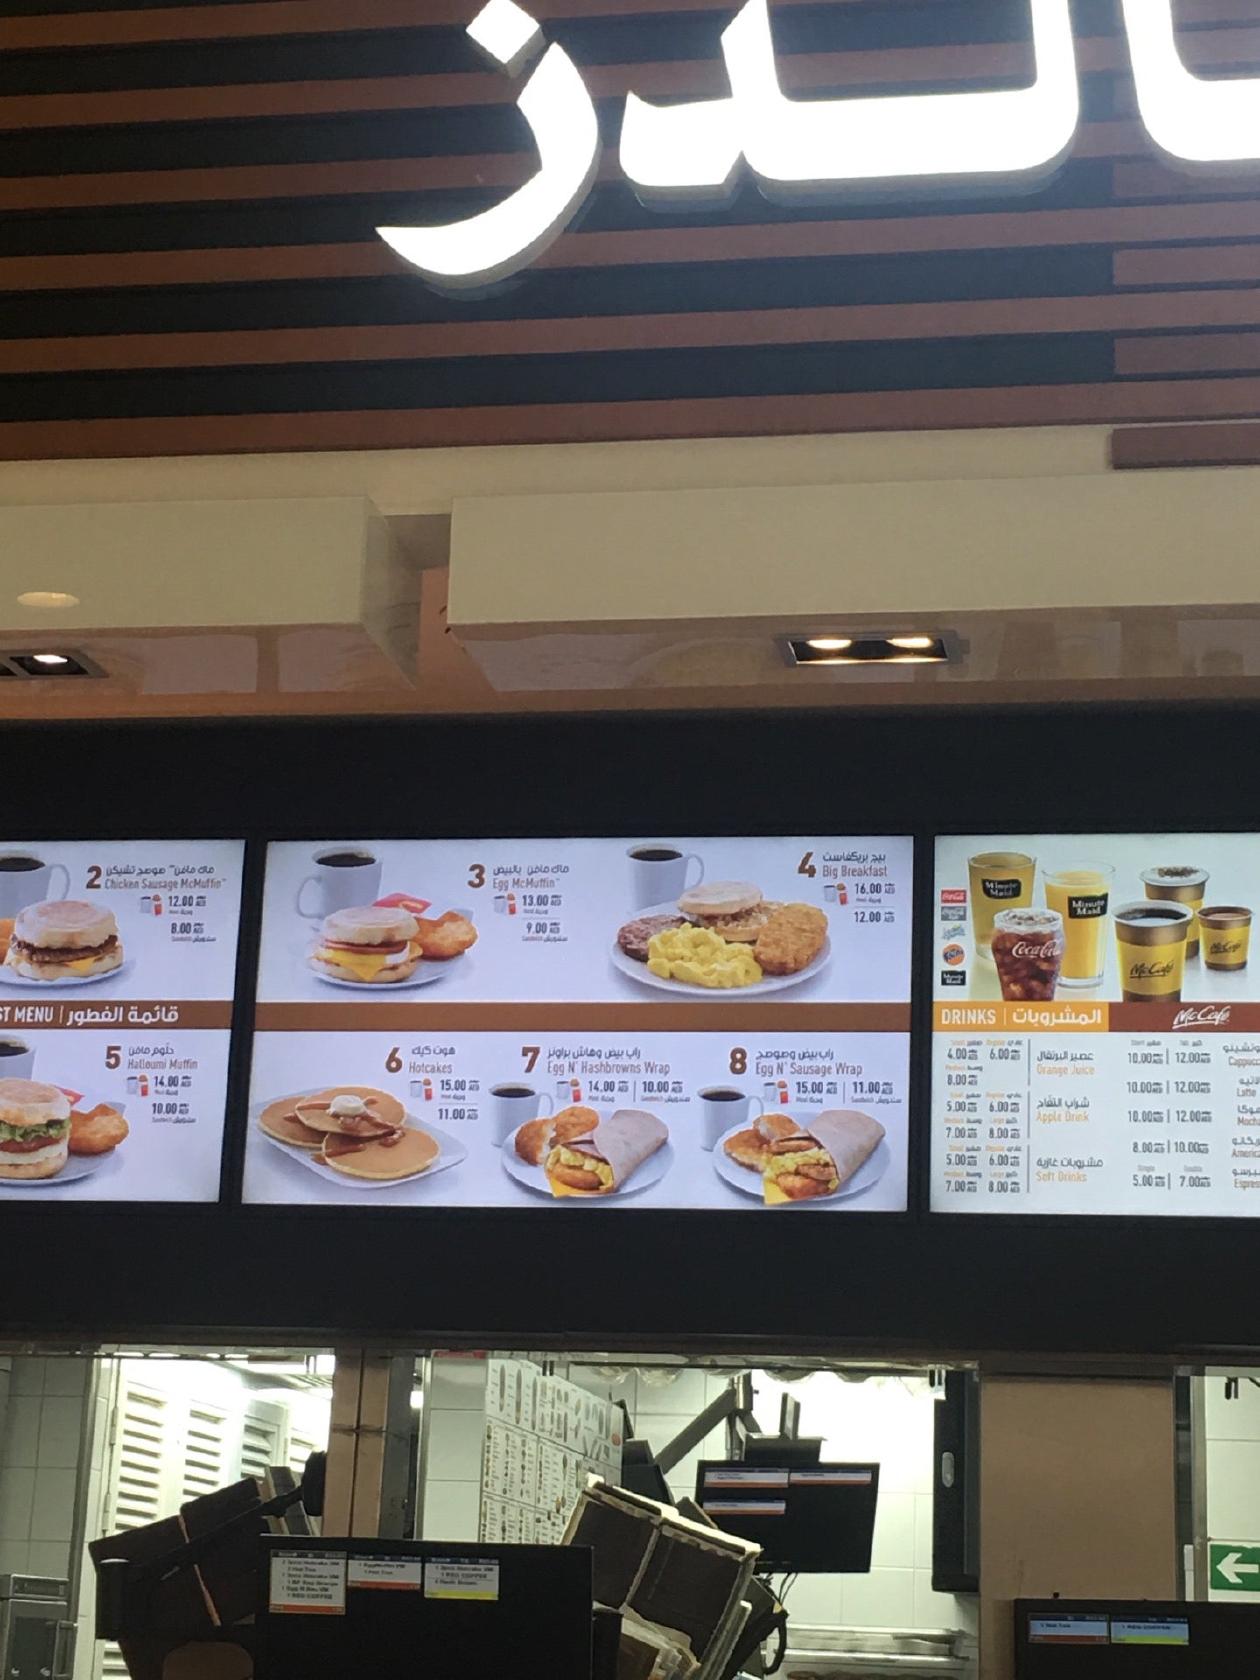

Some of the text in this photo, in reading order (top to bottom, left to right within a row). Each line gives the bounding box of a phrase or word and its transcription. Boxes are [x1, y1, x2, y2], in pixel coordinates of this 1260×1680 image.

[797, 852, 816, 878] 4
[86, 866, 102, 889] 2
[467, 864, 485, 888] 3
[822, 865, 887, 879] Big Breakfast
[105, 878, 139, 889] Chicken
[142, 878, 178, 891] Sausage
[493, 878, 509, 891] Egg
[855, 883, 881, 894] 16.00
[168, 896, 194, 907] 12.00
[522, 895, 548, 906] 13.00
[854, 911, 881, 923] 12.00
[171, 923, 191, 934] 8.00
[527, 922, 547, 934] 9.00
[14, 1006, 54, 1023] MENU
[67, 1005, 178, 1026] قائمة الفطور
[941, 1009, 996, 1024] DRINKS
[1012, 1005, 1101, 1026] المشروبات
[105, 1046, 121, 1069] 5
[947, 1048, 966, 1059] 4.00
[990, 1048, 1009, 1060] 6.00
[1128, 1053, 1152, 1064] 10.00
[1175, 1052, 1200, 1063] 12.00
[128, 1059, 198, 1069] Halloumi Muffin
[385, 1047, 403, 1073] 6
[522, 1047, 541, 1073] 7
[729, 1047, 747, 1075] 8
[409, 1062, 452, 1074] Hotcakes
[548, 1062, 564, 1076] Egg
[582, 1061, 641, 1073] Hashbrowns
[644, 1061, 670, 1076] Wrap
[756, 1063, 773, 1077] Egg
[790, 1063, 832, 1077] Sausage
[836, 1063, 862, 1077] Wrap
[1037, 1064, 1095, 1076] Orange Juice
[154, 1075, 179, 1087] 14.00
[440, 1079, 466, 1091] 15.00
[947, 1074, 966, 1085] 8.00
[588, 1081, 615, 1092] 14.00
[642, 1081, 669, 1093] 10.00
[796, 1082, 823, 1093] 15.00
[852, 1082, 879, 1093] 11.00
[1127, 1082, 1152, 1093] 10.00
[1174, 1081, 1200, 1093] 12.00
[1237, 1088, 1256, 1097] Latte
[152, 1103, 177, 1114] 10.00
[947, 1101, 966, 1111] 5.00
[989, 1101, 1008, 1112] 6.00
[438, 1109, 465, 1120] 11.00
[1037, 1111, 1088, 1123] Apple Drink
[1128, 1110, 1153, 1122] 10.00
[1176, 1110, 1200, 1122] 12.00
[946, 1127, 965, 1138] 7.00
[989, 1128, 1008, 1138] 8.00
[1133, 1142, 1153, 1153] 8.00
[1174, 1142, 1199, 1153] 10.00
[946, 1154, 965, 1165] 5.00
[989, 1155, 1008, 1166] 6.00
[1036, 1171, 1087, 1181] Soft Drinks
[1133, 1175, 1153, 1186] 5.00
[1179, 1176, 1200, 1187] 7.00
[946, 1181, 965, 1192] 7.00
[989, 1181, 1008, 1192] 8.00
